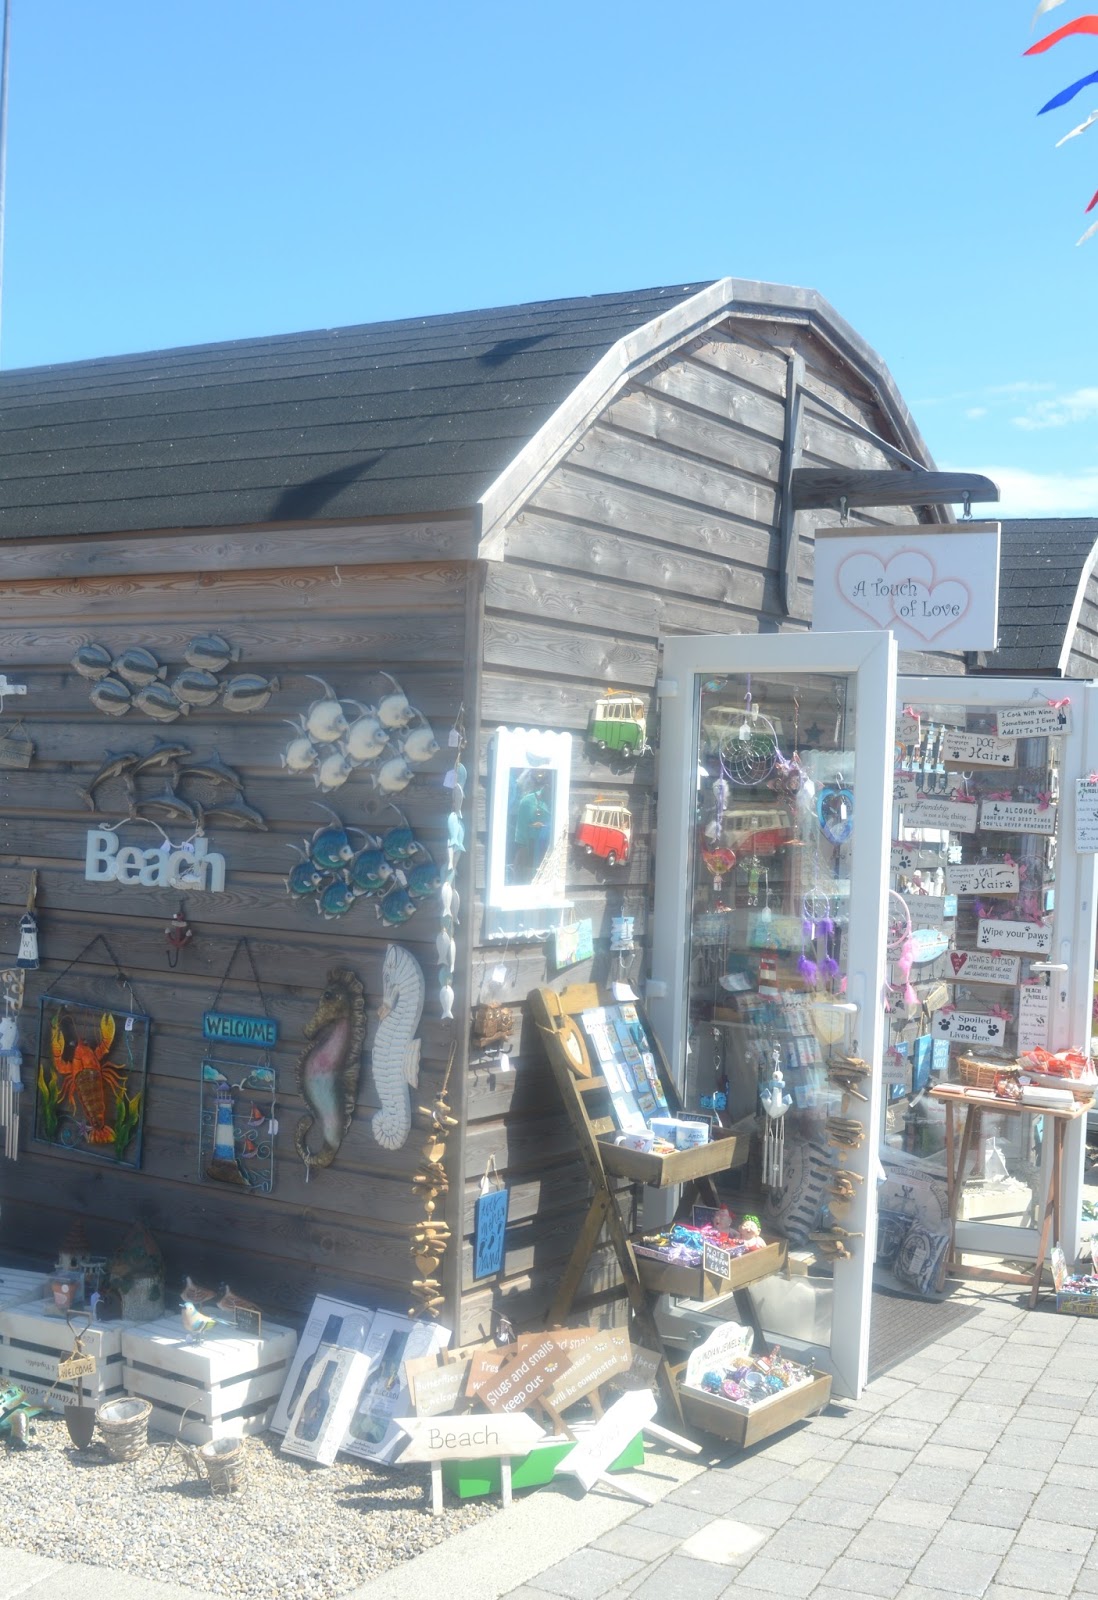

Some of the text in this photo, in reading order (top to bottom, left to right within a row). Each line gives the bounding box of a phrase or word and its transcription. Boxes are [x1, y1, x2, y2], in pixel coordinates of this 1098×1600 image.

[852, 578, 918, 597] A Touch
[899, 600, 961, 617] of Love
[1002, 719, 1034, 727] Sometimes
[1002, 728, 1014, 736] Add
[1048, 724, 1063, 732] Food
[976, 737, 996, 749] DOG
[968, 746, 1000, 760] Hair
[910, 800, 950, 813] Friendship
[1004, 807, 1037, 815] ALCOHOL
[84, 829, 226, 893] Beach
[978, 868, 994, 878] CAT
[974, 878, 1005, 890] Hair
[982, 926, 1048, 940] Wipe your paws
[991, 957, 1016, 966] KITCHEN
[958, 1015, 992, 1024] Spoiled
[205, 1017, 275, 1044] WELCOME
[950, 1032, 990, 1042] Lives Here
[706, 1246, 724, 1259] NOTE
[61, 1363, 94, 1378] WELCOME
[480, 1362, 500, 1374] Tres
[486, 1339, 555, 1406] Slugs and snails
[550, 1390, 571, 1408] will
[566, 1382, 578, 1397] be
[576, 1356, 617, 1383] composted
[501, 1375, 544, 1414] keep out
[427, 1425, 500, 1449] Beach
